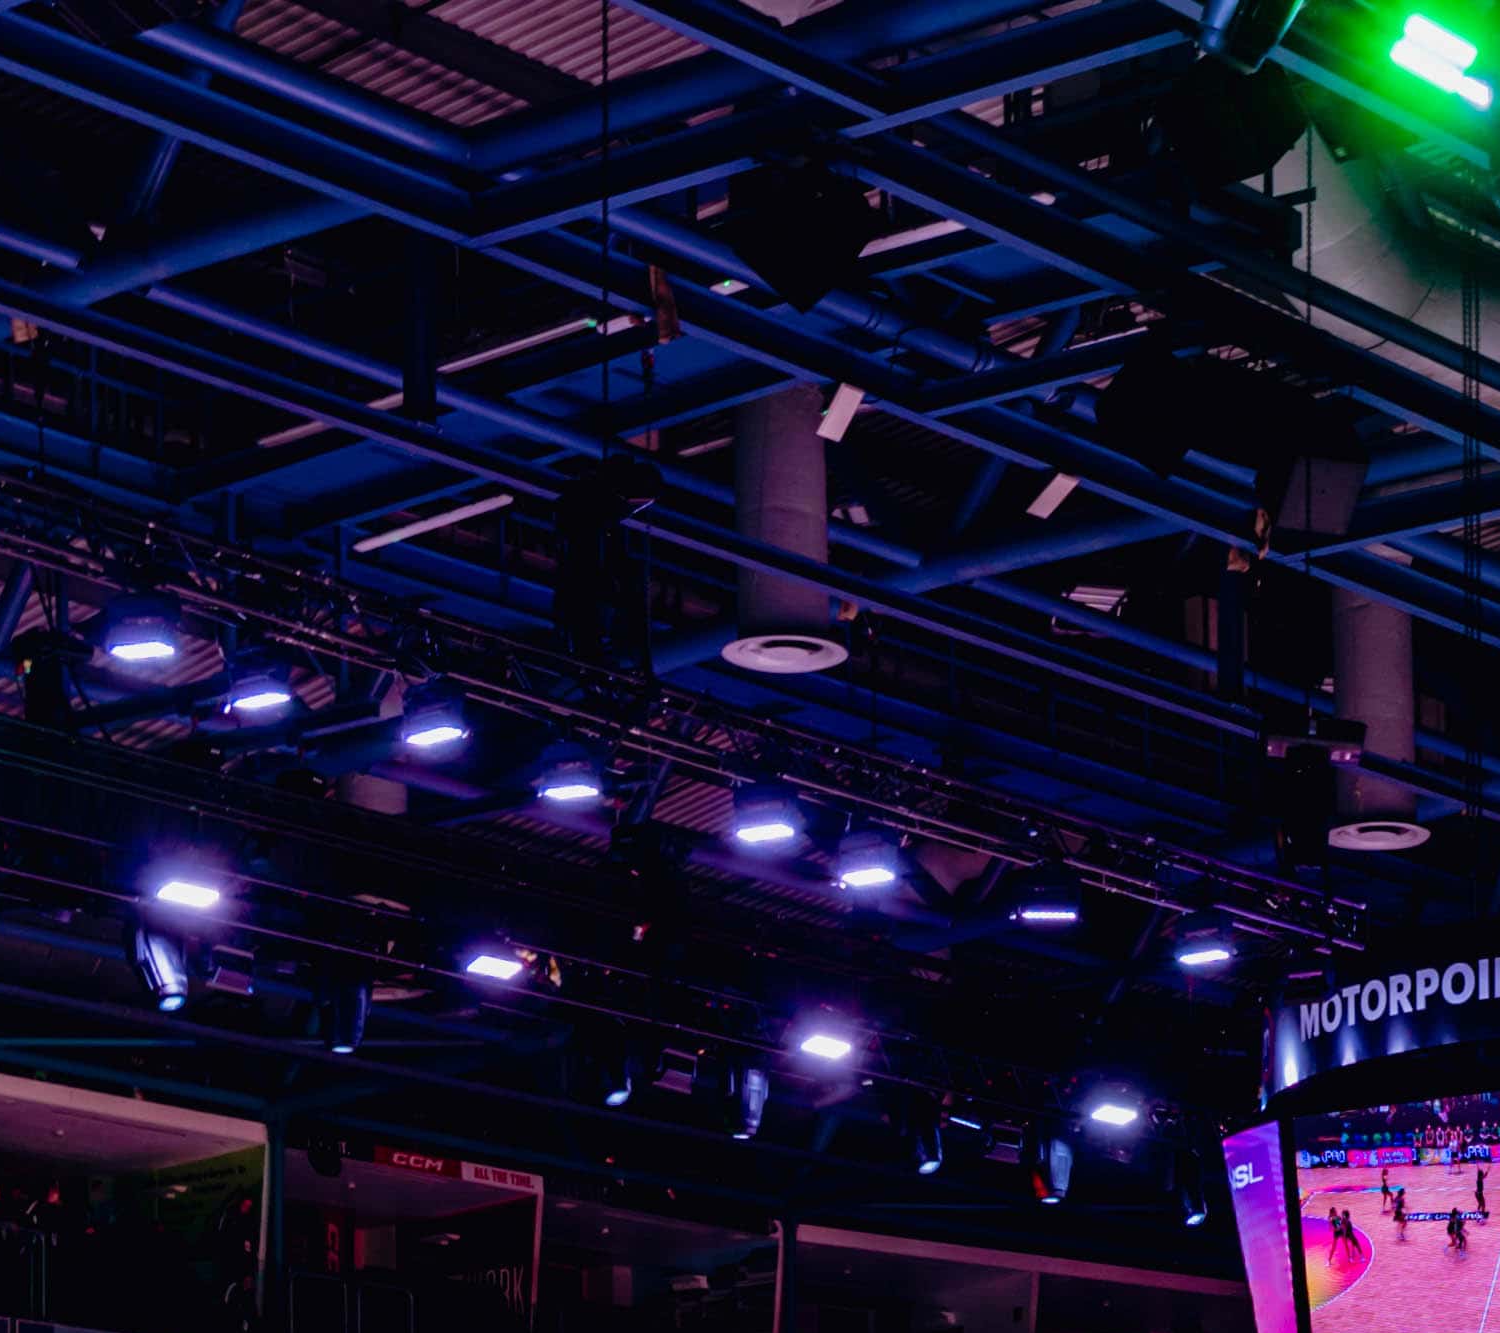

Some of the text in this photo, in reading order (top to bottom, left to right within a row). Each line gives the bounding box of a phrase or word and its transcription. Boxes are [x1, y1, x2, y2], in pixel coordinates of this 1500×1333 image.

[392, 1151, 444, 1172] CCM
[473, 1167, 490, 1181] ALL
[491, 1169, 509, 1184] THE
